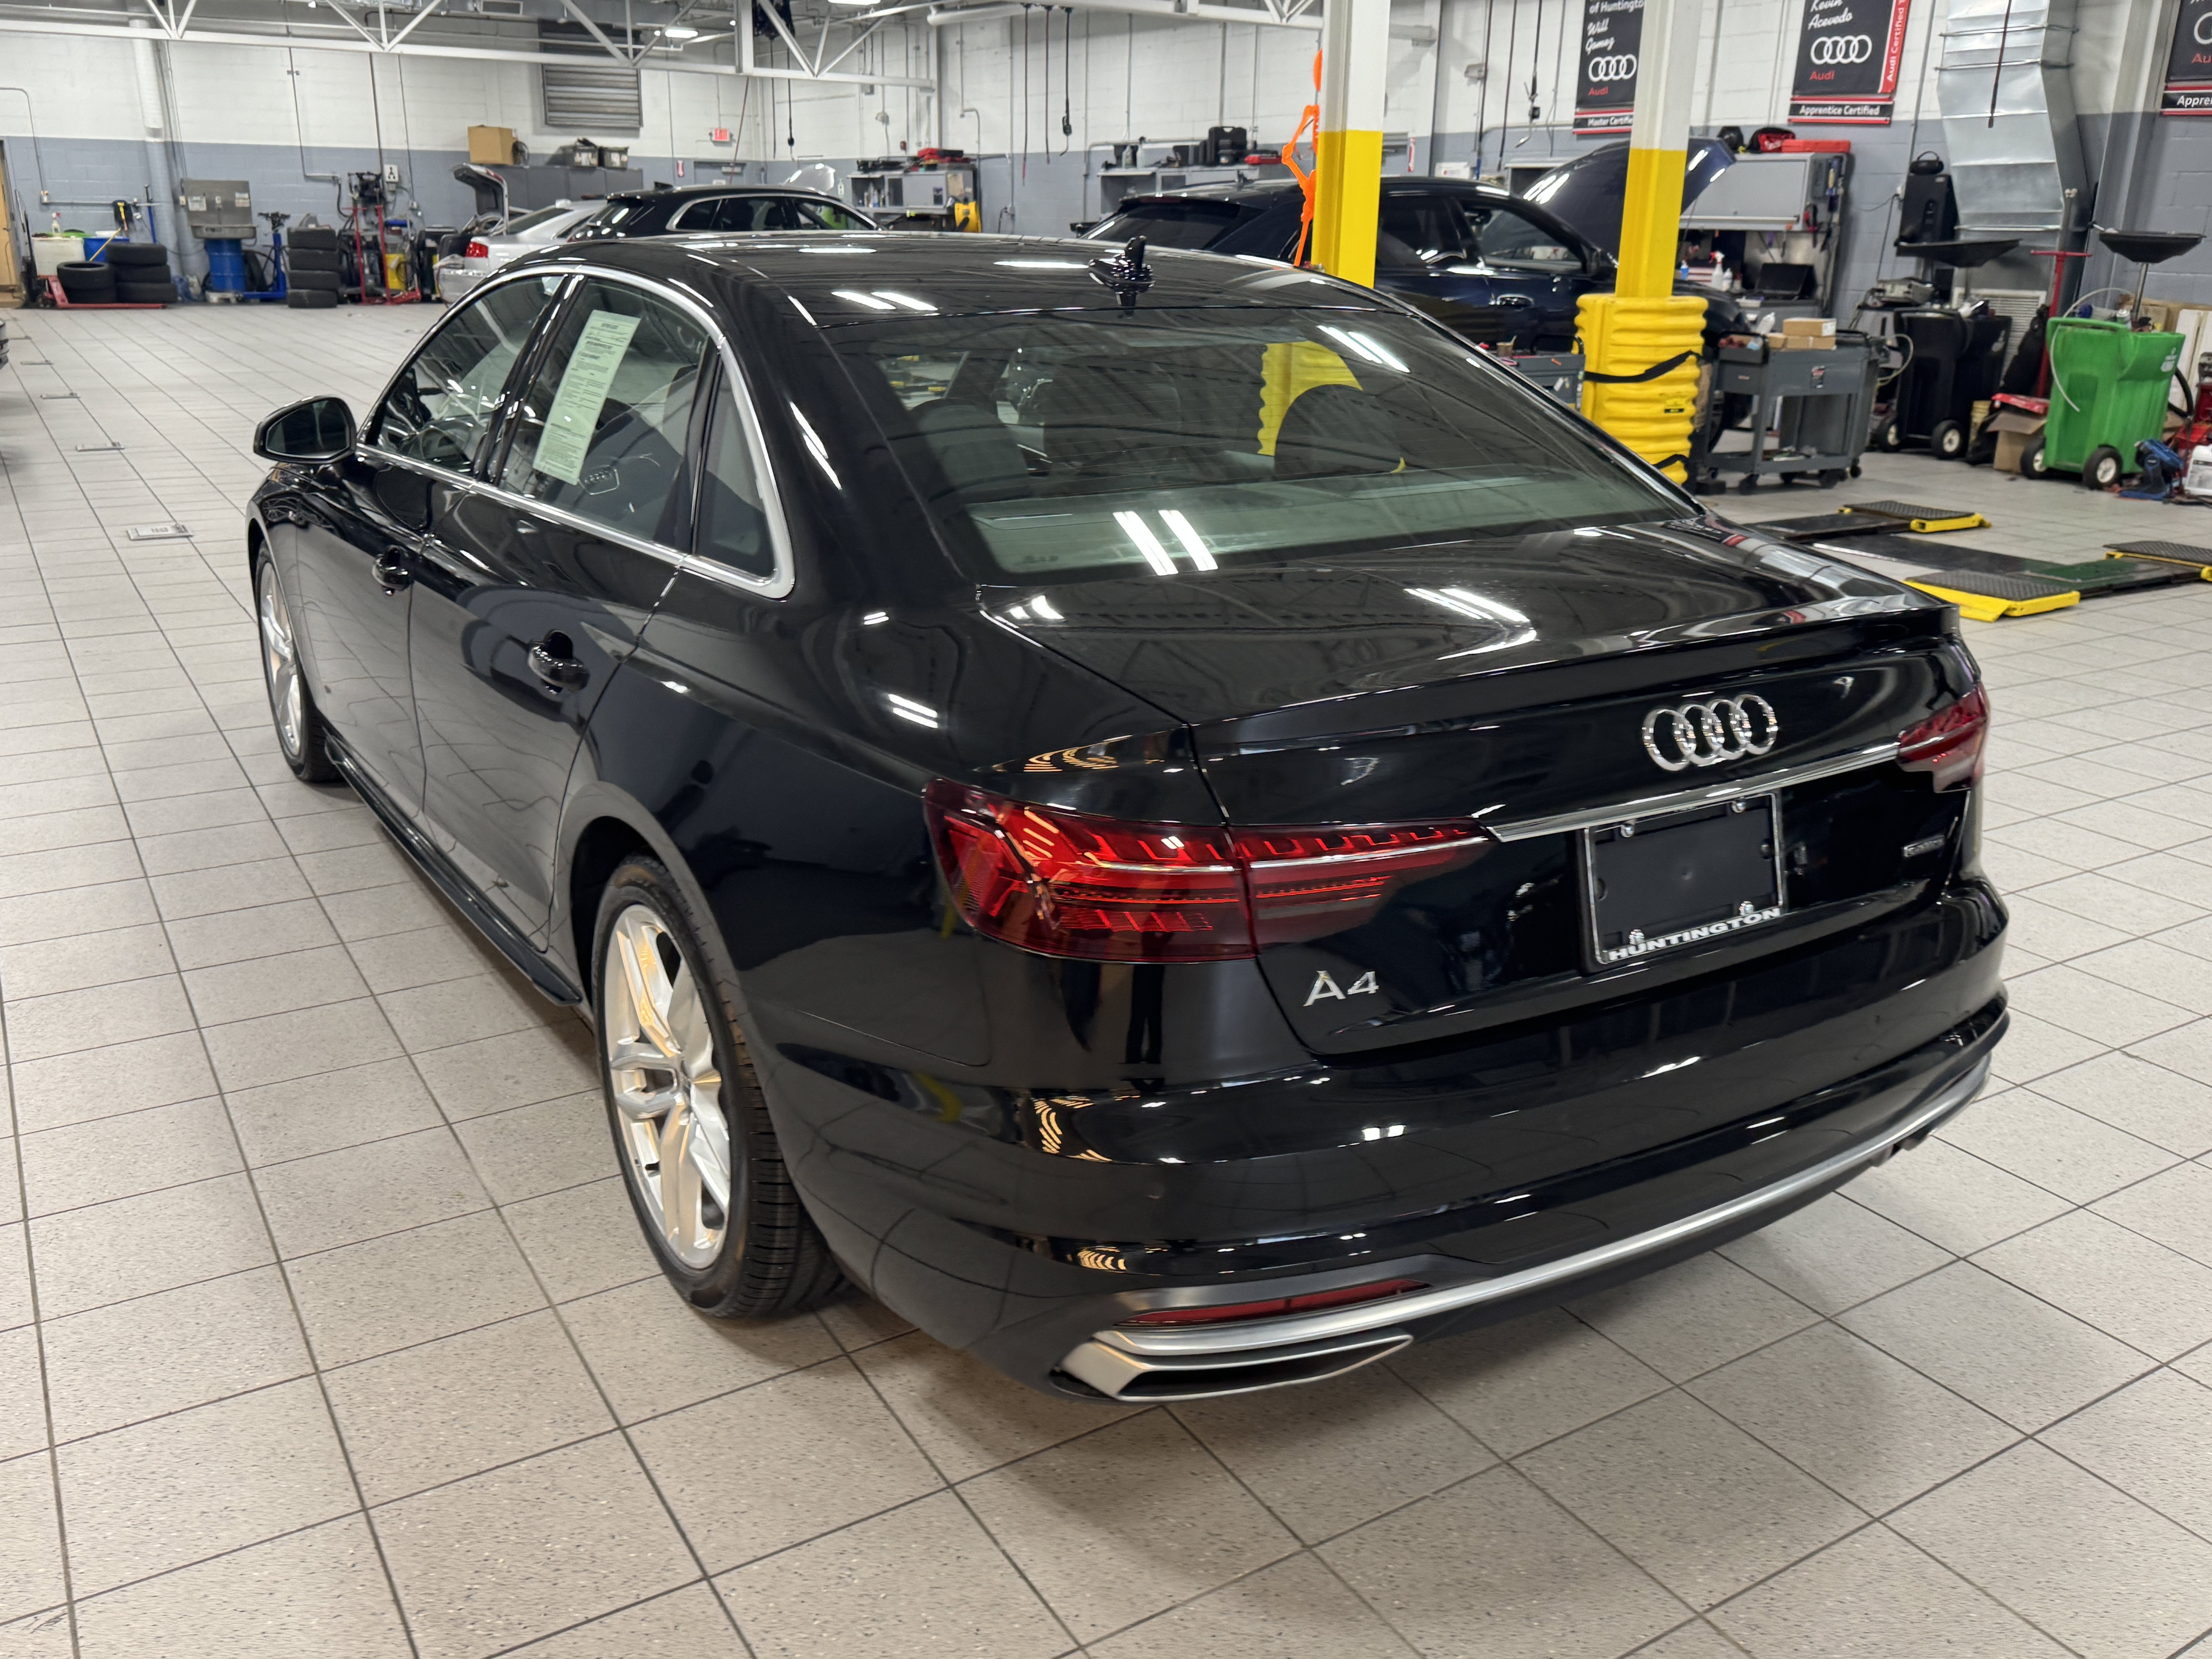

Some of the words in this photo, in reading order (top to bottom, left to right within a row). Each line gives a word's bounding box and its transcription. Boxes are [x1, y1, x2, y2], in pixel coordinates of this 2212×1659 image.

[1589, 2, 1600, 14] of
[1601, 0, 1644, 13] Huntingto
[1808, 7, 1853, 30] Acevedo
[1891, 7, 1904, 53] Certified
[2191, 53, 2212, 63] Au
[1809, 70, 1836, 80] Audi
[1887, 56, 1897, 82] Audi
[1589, 86, 1609, 95] Audi
[1799, 105, 1842, 116] Apprentice
[1843, 105, 1880, 115] Certified
[1609, 908, 1781, 961] HUNTINGTON
[1303, 970, 1380, 1007] A4
